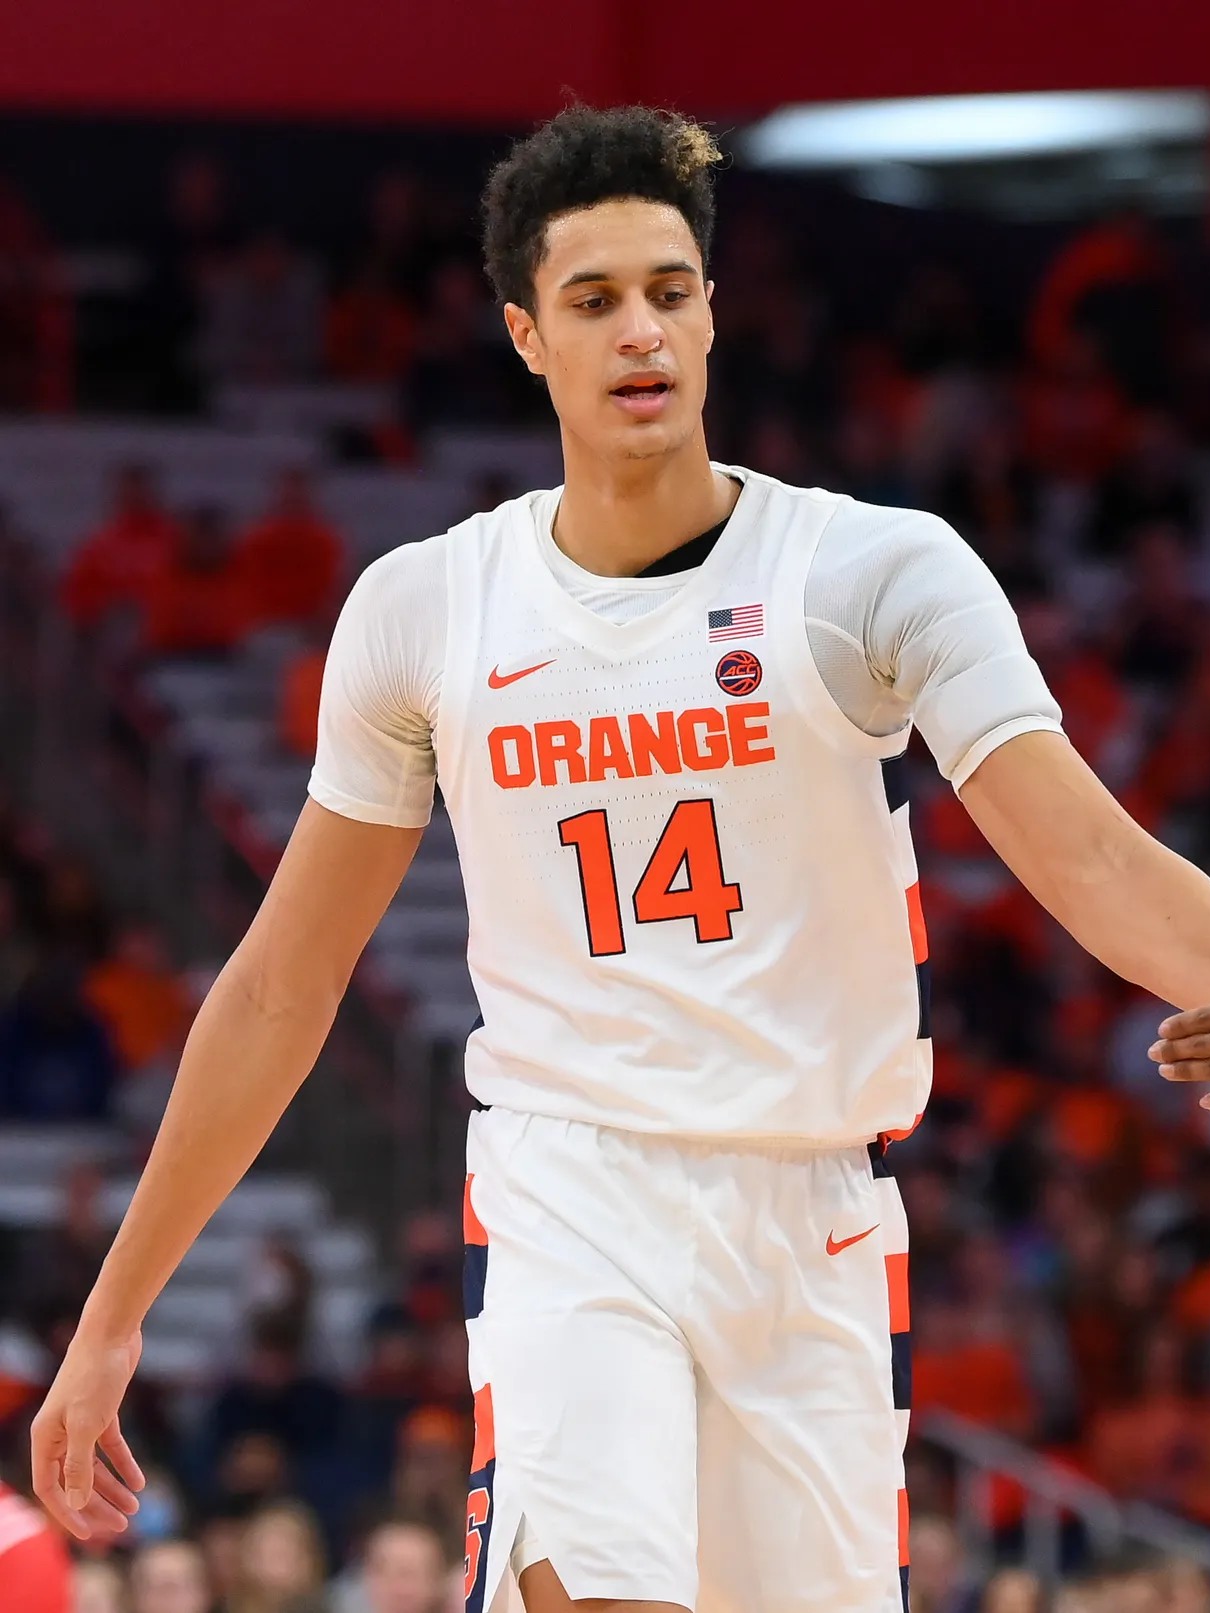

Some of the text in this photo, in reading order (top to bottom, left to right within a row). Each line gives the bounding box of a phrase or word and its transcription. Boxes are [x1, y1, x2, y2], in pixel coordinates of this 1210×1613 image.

[723, 663, 759, 677] ACC
[487, 702, 775, 789] ORANGE
[557, 798, 743, 957] 14
